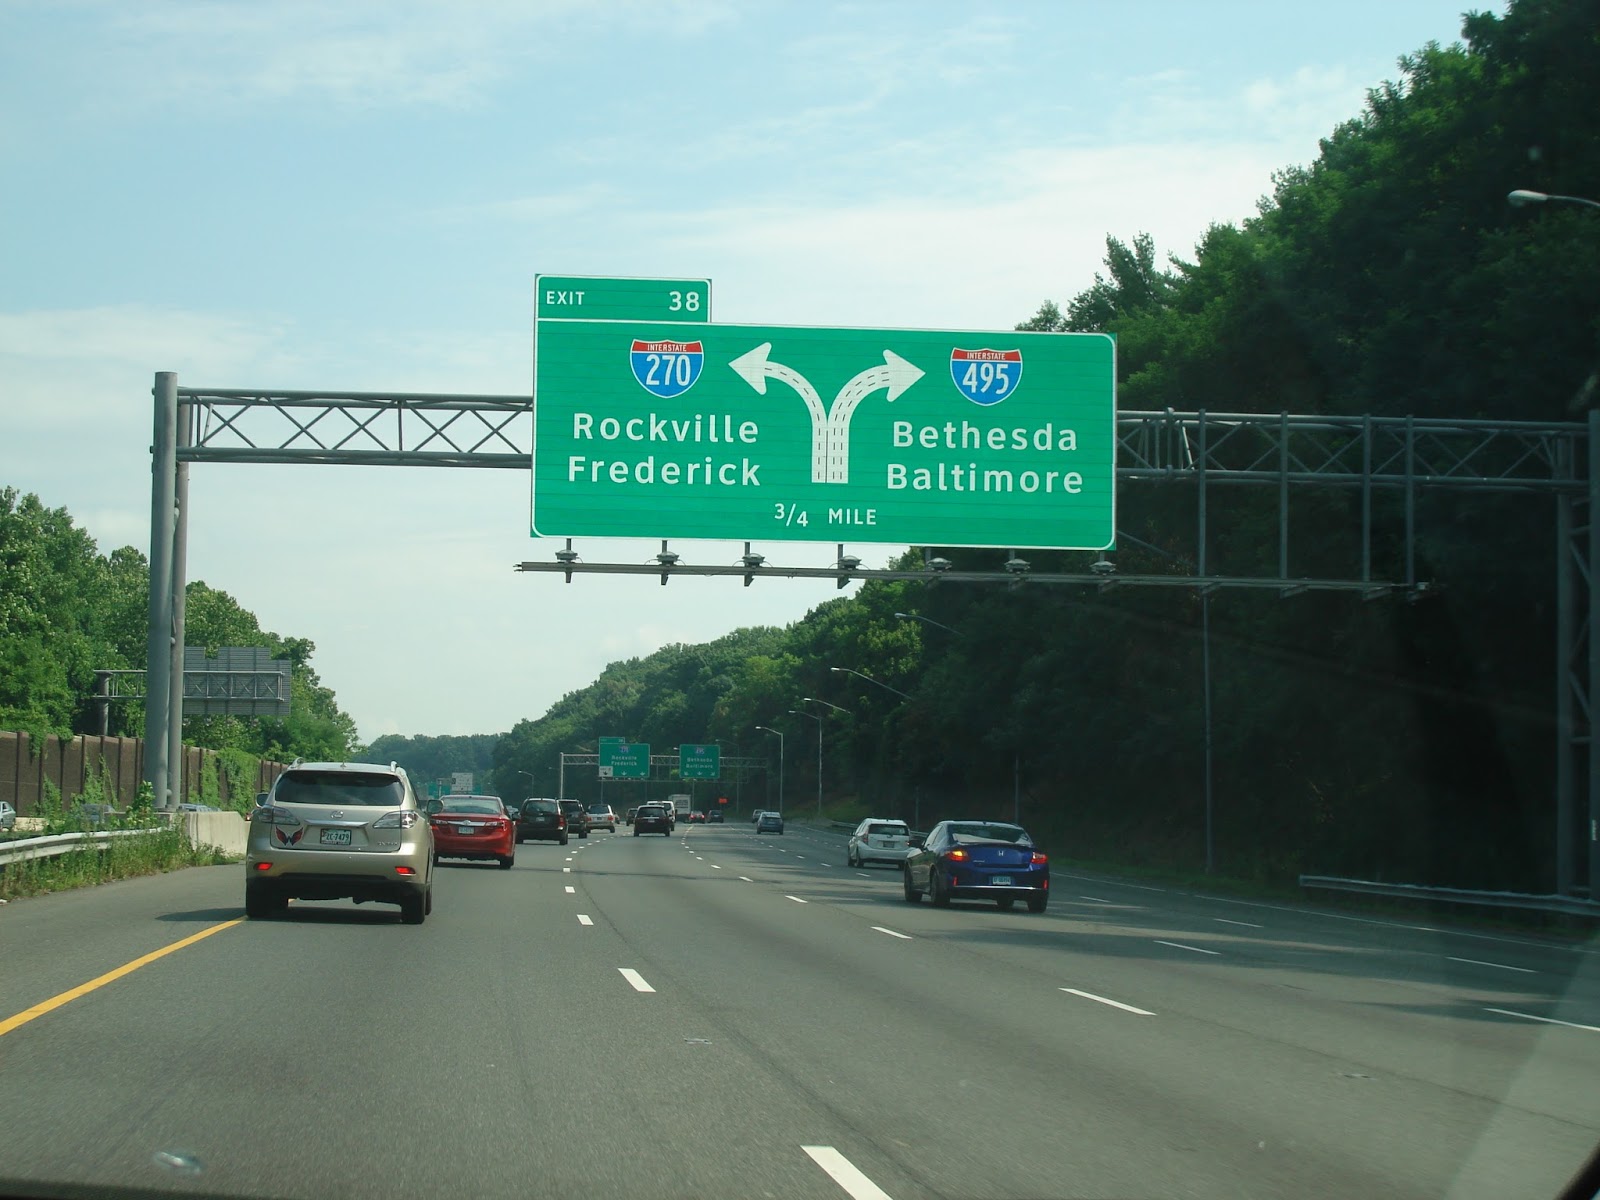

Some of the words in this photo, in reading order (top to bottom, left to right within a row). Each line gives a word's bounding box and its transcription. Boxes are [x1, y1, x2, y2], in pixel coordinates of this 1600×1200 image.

[546, 291, 584, 305] EXIT
[669, 291, 700, 312] 38
[647, 343, 687, 352] INTERSTATE
[966, 352, 1006, 361] INTERSTATE
[645, 353, 691, 386] 270
[962, 363, 1009, 395] 495
[573, 413, 758, 444] Rockville
[893, 421, 1077, 451] Bethesda
[568, 456, 760, 486] Frederick
[887, 463, 1083, 494] Baltimore
[774, 504, 809, 527] 3/4
[828, 509, 876, 525] MILE
